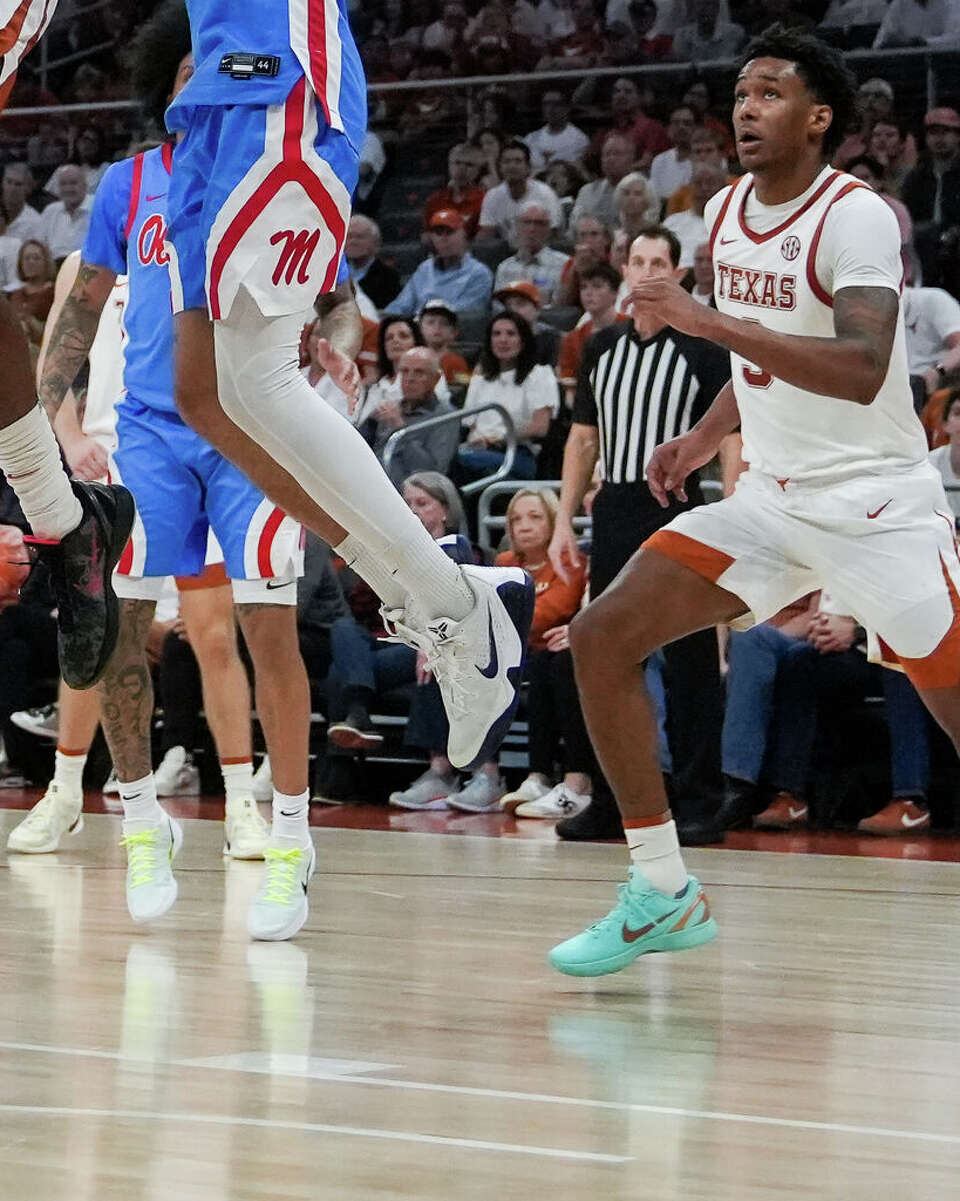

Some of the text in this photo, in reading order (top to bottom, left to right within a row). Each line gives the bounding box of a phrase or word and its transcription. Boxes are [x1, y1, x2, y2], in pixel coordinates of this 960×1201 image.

[257, 60, 269, 70] 44
[269, 228, 321, 286] M
[717, 263, 797, 311] TEXAS
